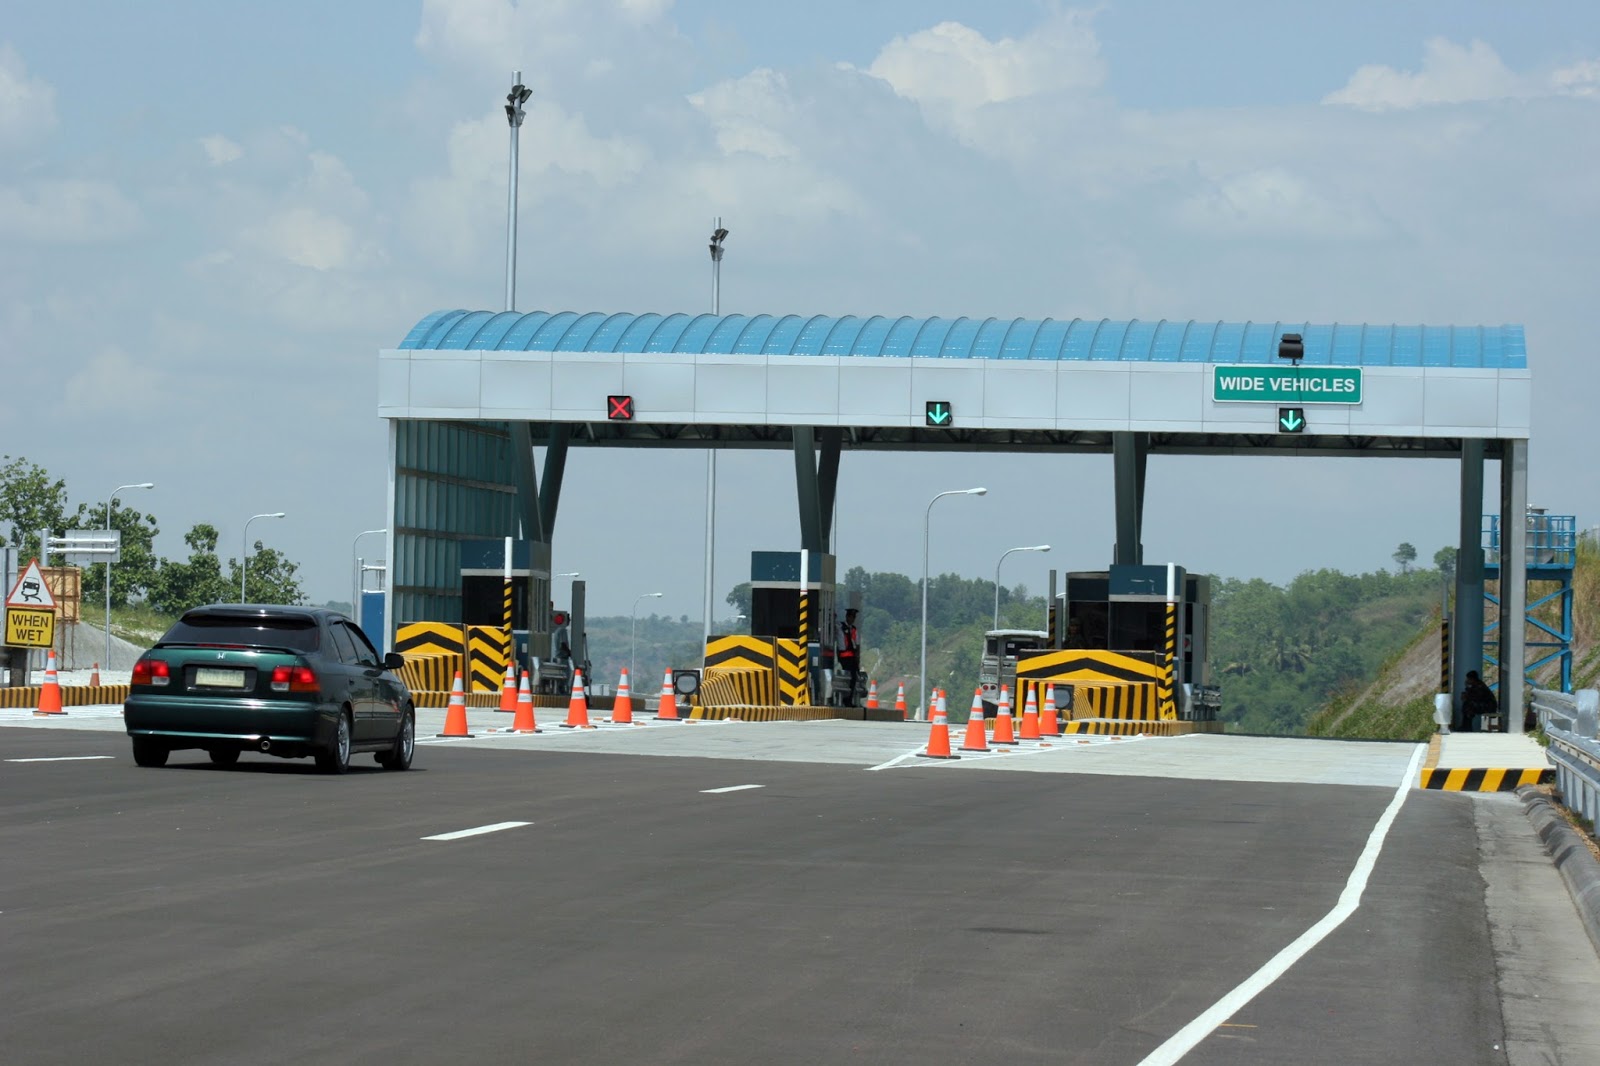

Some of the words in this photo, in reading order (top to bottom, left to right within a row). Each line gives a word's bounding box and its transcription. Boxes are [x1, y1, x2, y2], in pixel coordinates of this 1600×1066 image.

[1220, 377, 1264, 391] WIDE
[1270, 378, 1355, 392] VEHICLES
[12, 614, 49, 628] WHEN
[16, 629, 44, 642] WET
